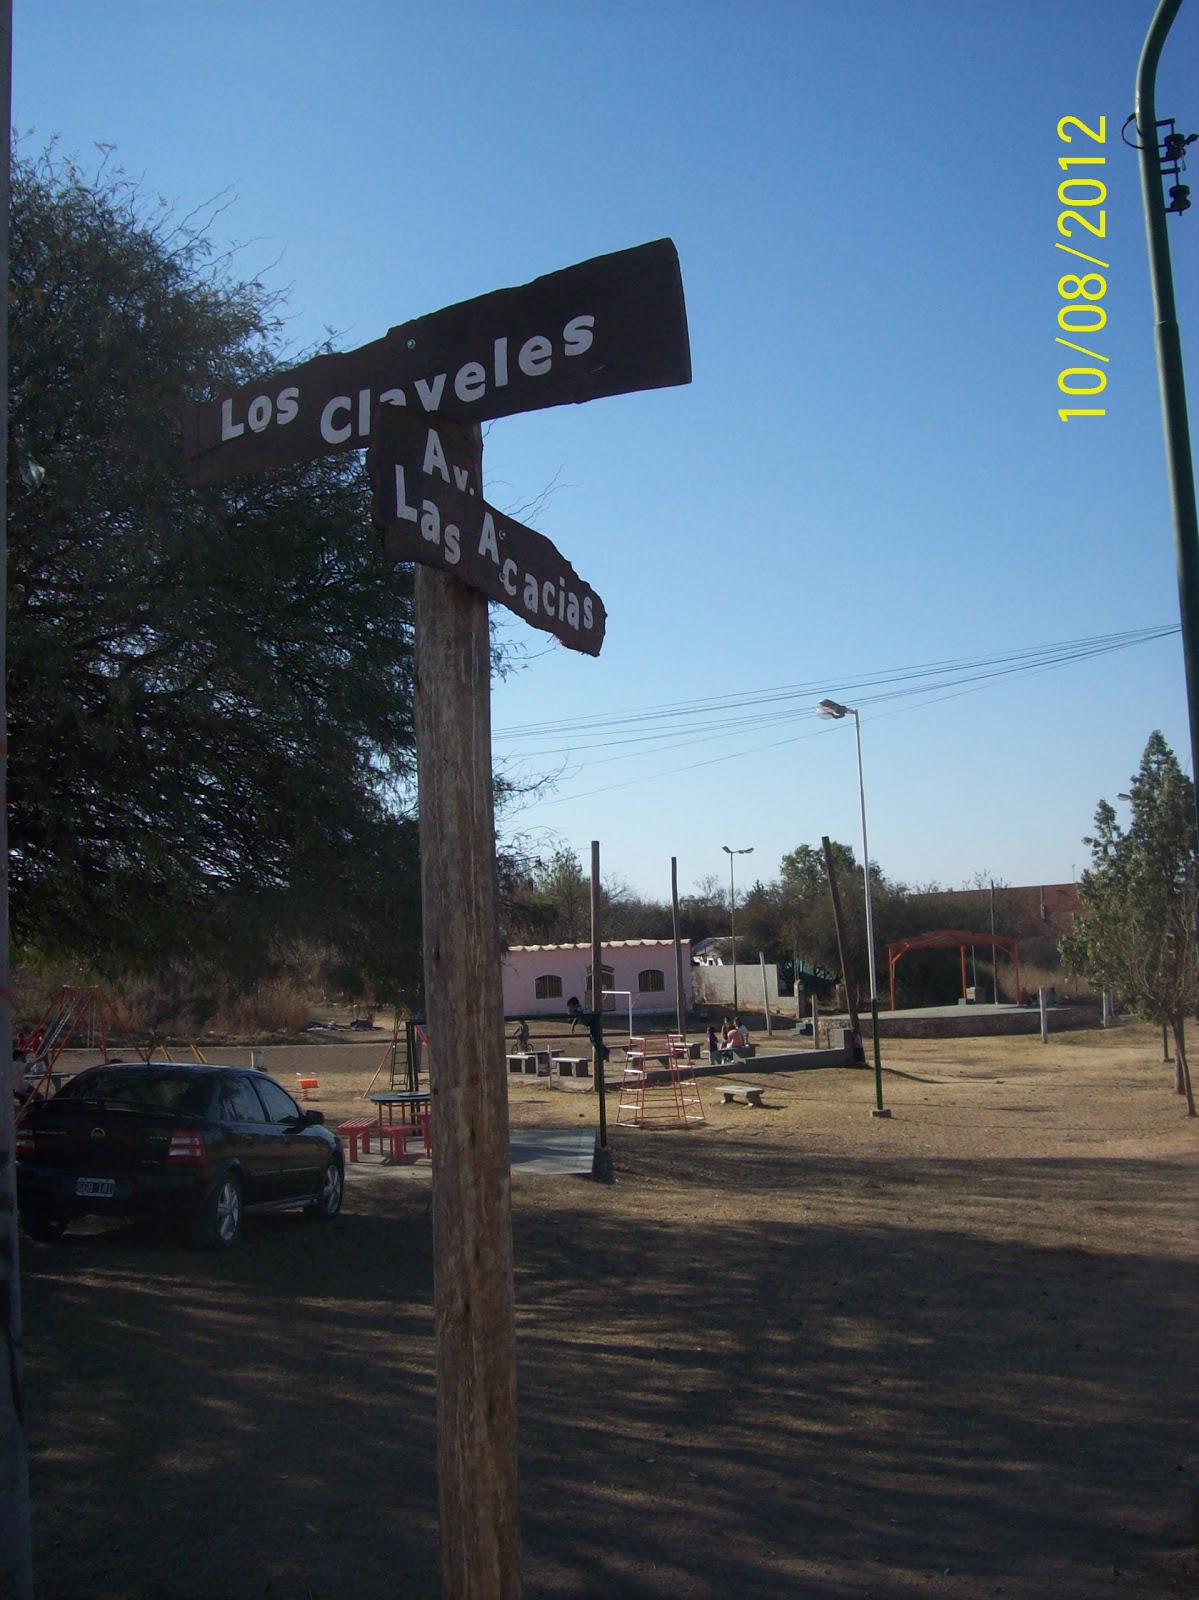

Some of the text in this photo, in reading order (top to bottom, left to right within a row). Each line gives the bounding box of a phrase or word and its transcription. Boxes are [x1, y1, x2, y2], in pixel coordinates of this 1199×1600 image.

[221, 387, 300, 442] Los
[422, 428, 476, 497] Av.
[394, 464, 595, 632] Las Acacias
